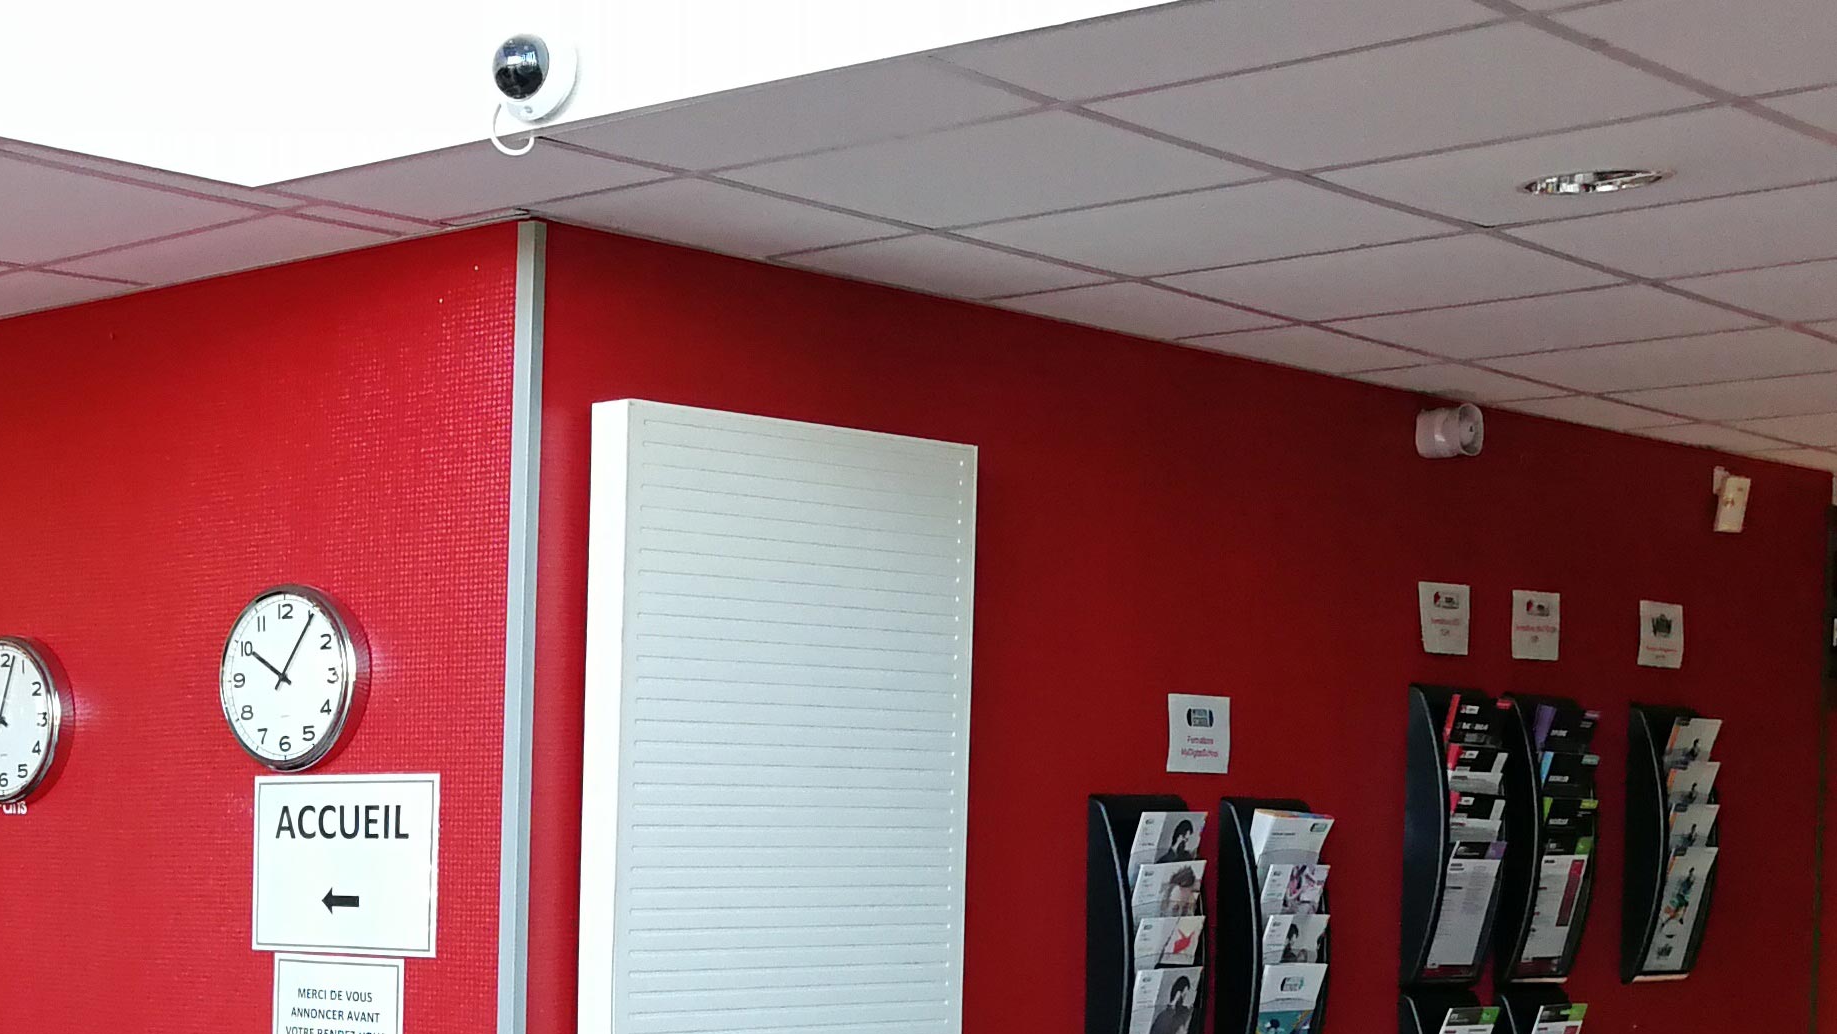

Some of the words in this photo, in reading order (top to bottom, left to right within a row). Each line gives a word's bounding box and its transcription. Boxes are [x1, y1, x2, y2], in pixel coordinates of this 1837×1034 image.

[277, 603, 293, 620] 12
[257, 616, 266, 632] 11
[240, 641, 252, 657] 10
[320, 634, 332, 650] 2
[233, 673, 245, 688] 9
[326, 668, 339, 684] 3
[32, 682, 42, 696] 2
[240, 705, 254, 721] 8
[320, 699, 331, 715] 4
[37, 712, 48, 727] 3
[257, 728, 268, 745] 7
[302, 725, 316, 742] 5
[32, 741, 41, 755] 4
[279, 735, 291, 752] 6
[18, 764, 28, 778] 5
[275, 805, 409, 839] ACCUEIL
[297, 987, 327, 1000] MERCI
[330, 990, 343, 1001] DE
[346, 991, 373, 1003] VOUS
[291, 1006, 344, 1021] ANNONCER
[347, 1010, 380, 1023] AVANT
